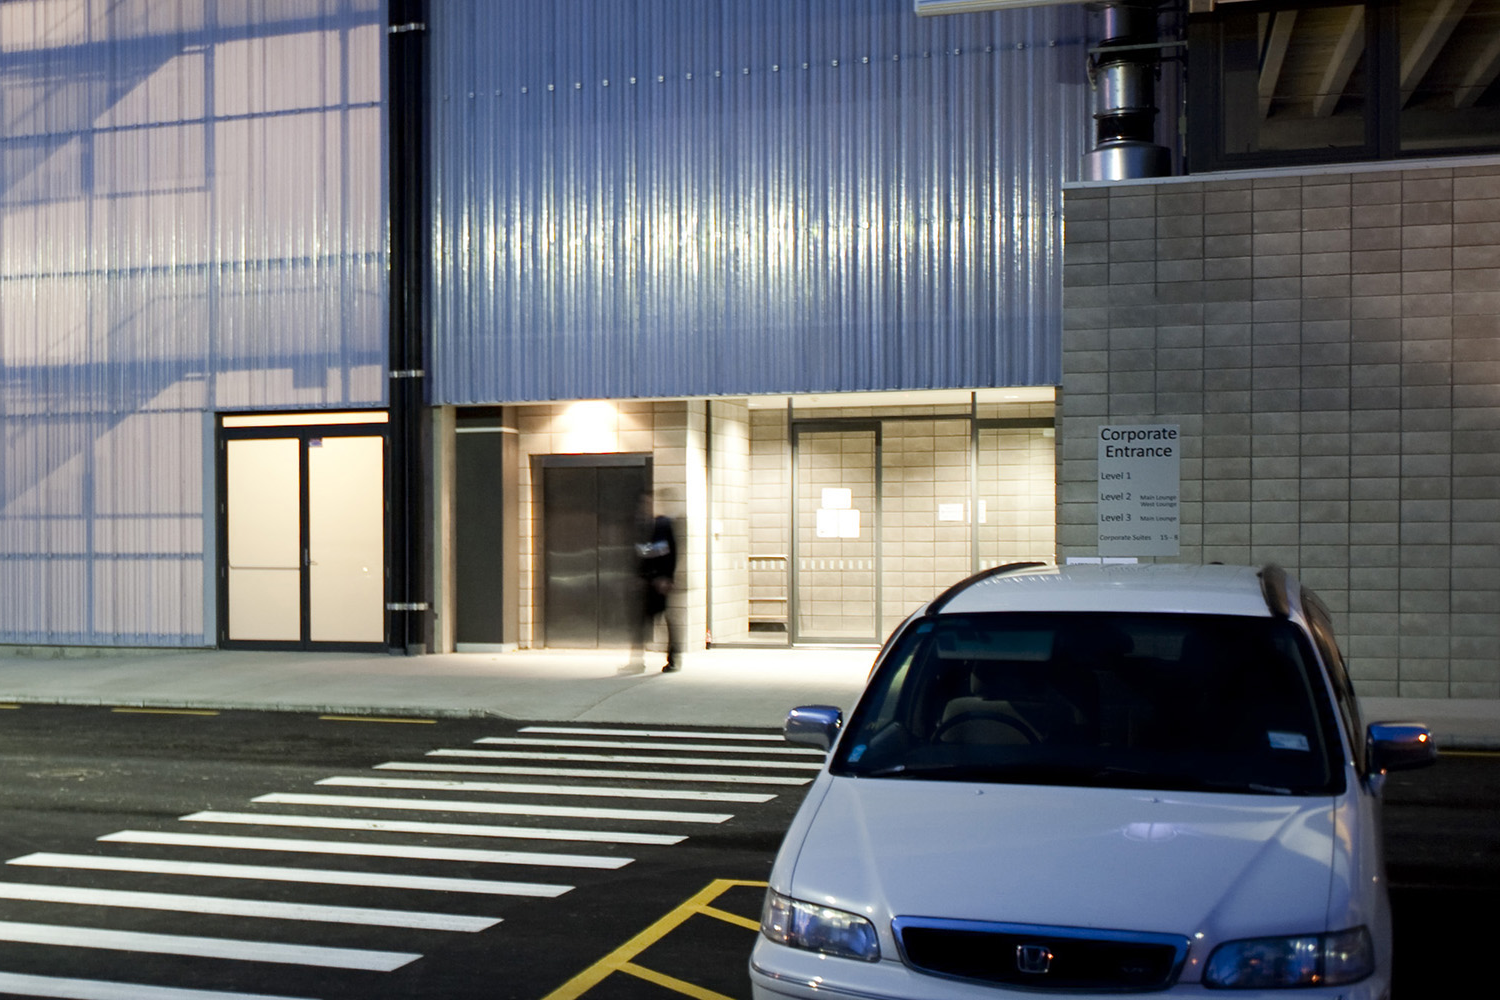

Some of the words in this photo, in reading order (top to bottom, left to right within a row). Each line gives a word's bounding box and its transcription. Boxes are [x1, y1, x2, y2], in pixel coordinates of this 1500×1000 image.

[1100, 427, 1178, 443] Corporate
[1105, 445, 1173, 458] Entrance
[1100, 471, 1124, 480] Level
[1125, 472, 1132, 480] 1
[1100, 492, 1124, 501] Level
[1125, 492, 1132, 501] 2
[1100, 513, 1124, 522] Level
[1125, 513, 1132, 522] 3
